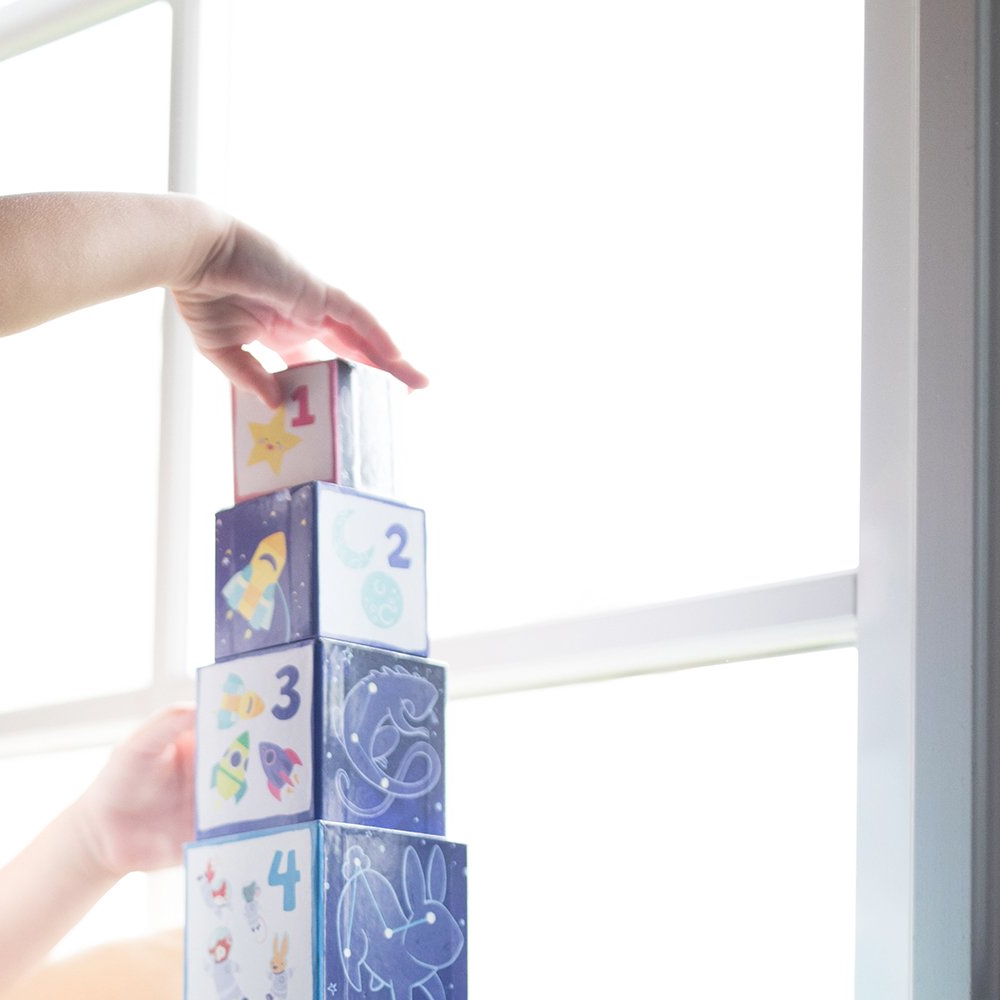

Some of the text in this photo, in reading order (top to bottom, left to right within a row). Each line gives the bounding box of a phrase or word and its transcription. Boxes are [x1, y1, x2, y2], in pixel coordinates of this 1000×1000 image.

[291, 384, 316, 427] 1
[385, 523, 411, 569] 2
[271, 665, 301, 720] 3
[268, 849, 300, 912] 4
